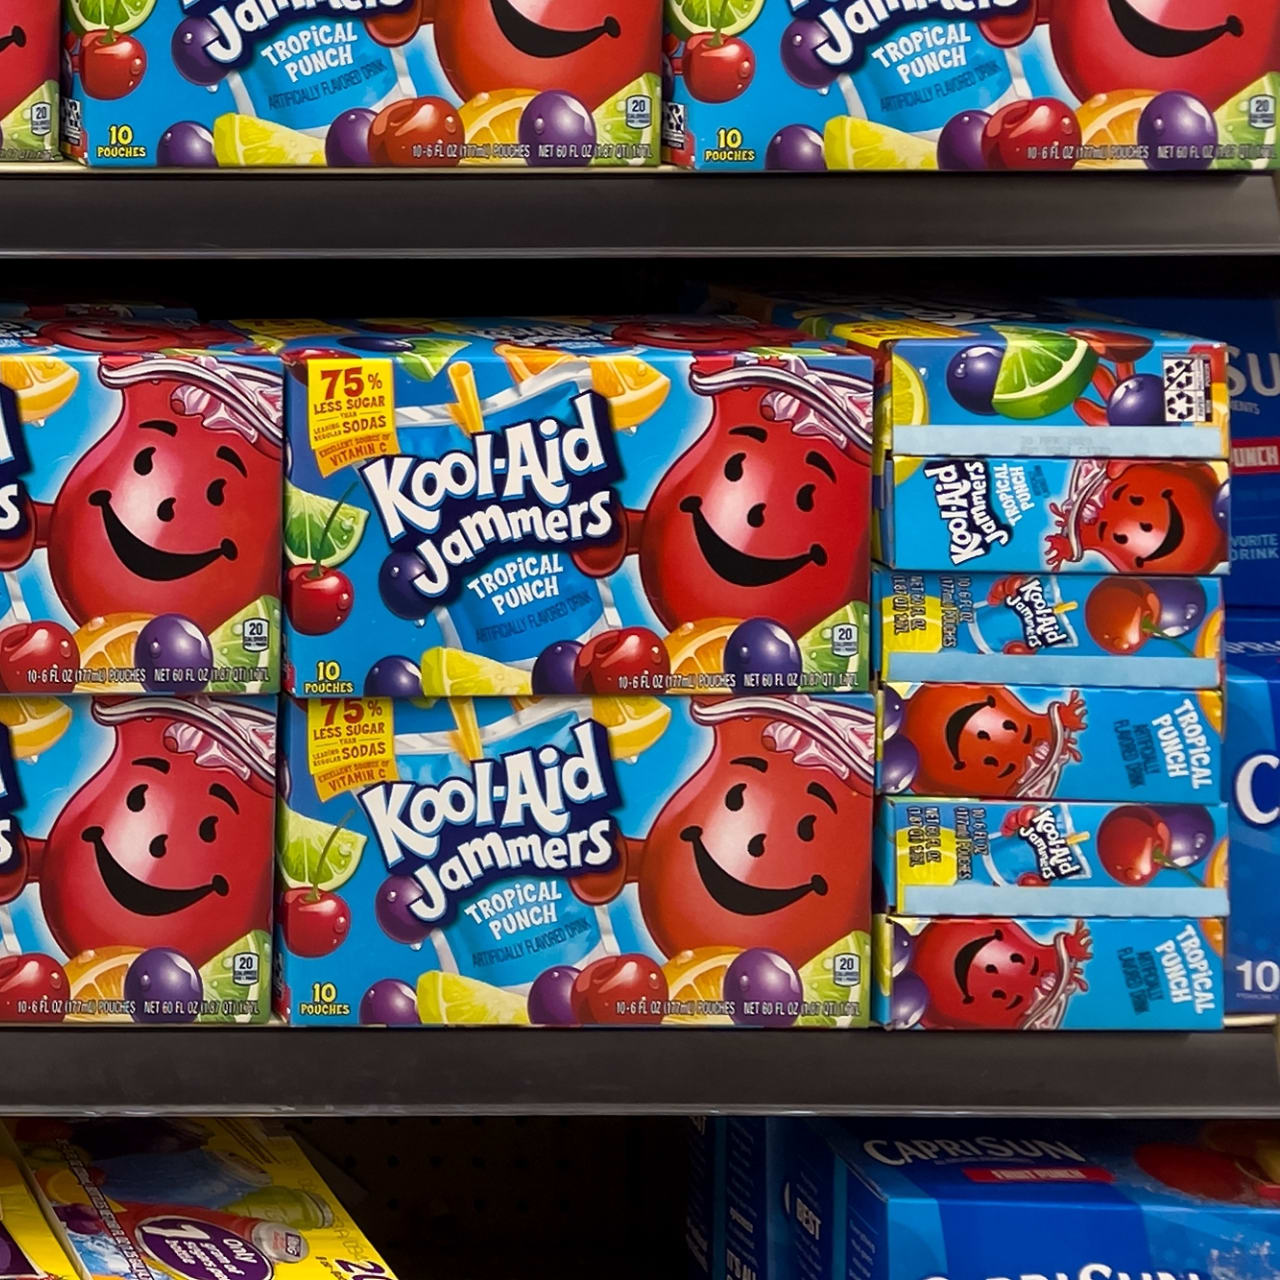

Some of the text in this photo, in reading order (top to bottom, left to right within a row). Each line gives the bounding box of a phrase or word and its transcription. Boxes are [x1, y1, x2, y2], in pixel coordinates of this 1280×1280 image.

[365, 392, 606, 539] Kool-Aid
[1008, 466, 1035, 511] PUNCH
[924, 464, 986, 565] Kool-Aid
[964, 461, 1009, 545] Jammers
[412, 491, 612, 595] Jammers
[1006, 596, 1042, 648] Jammers
[1020, 578, 1067, 645] Kool-Aid
[1152, 713, 1190, 778] PUNCH
[1032, 808, 1081, 874] Kool-Aid
